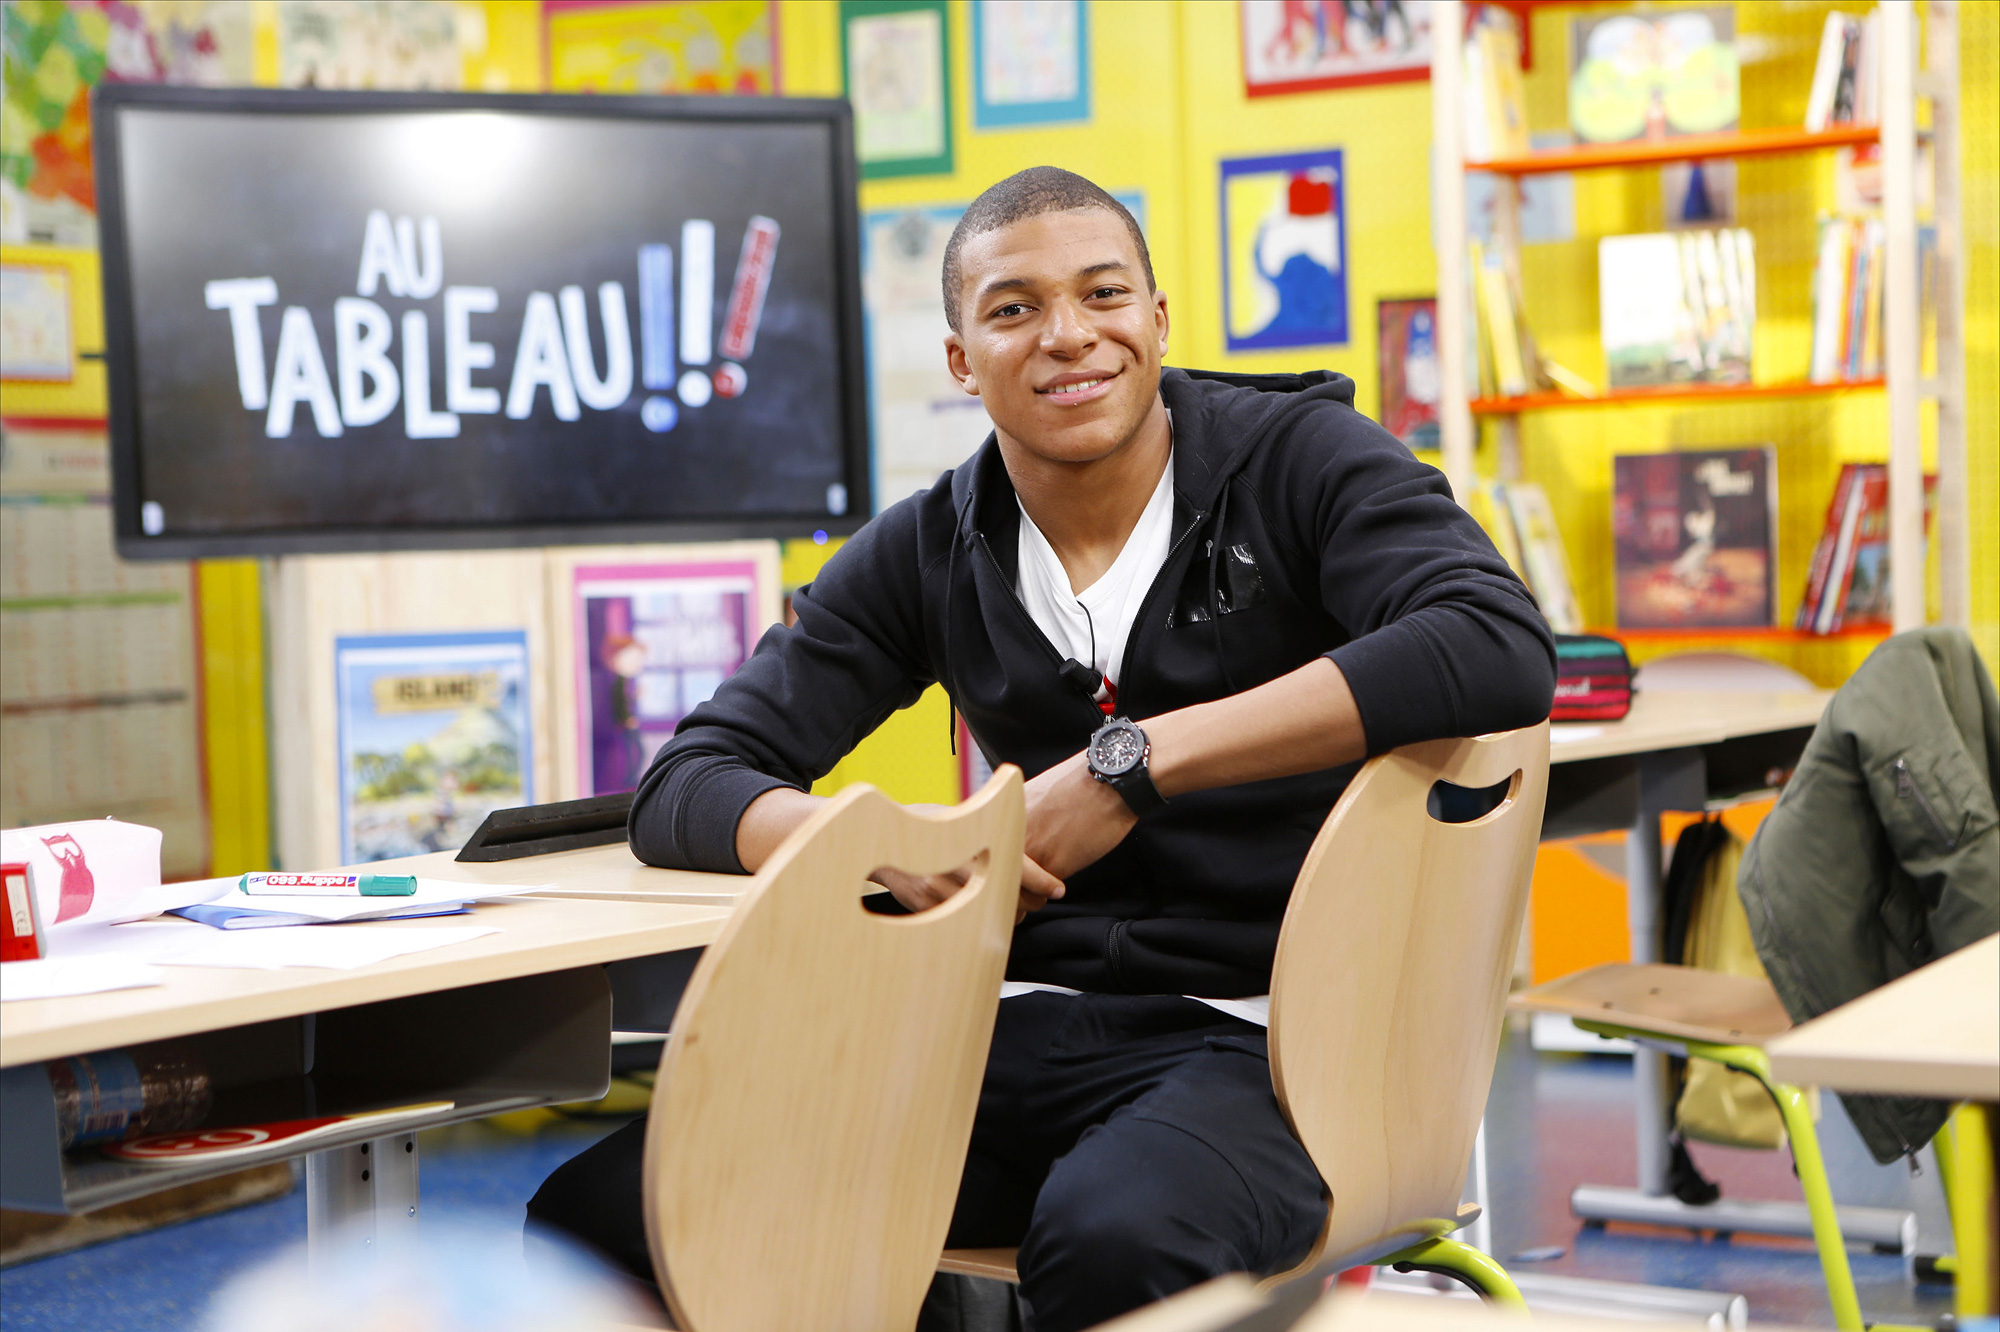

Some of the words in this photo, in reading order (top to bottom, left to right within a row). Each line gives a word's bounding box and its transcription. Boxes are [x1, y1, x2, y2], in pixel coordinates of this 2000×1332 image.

[357, 209, 443, 298] AU
[268, 875, 298, 885] 660
[300, 875, 345, 886] edding
